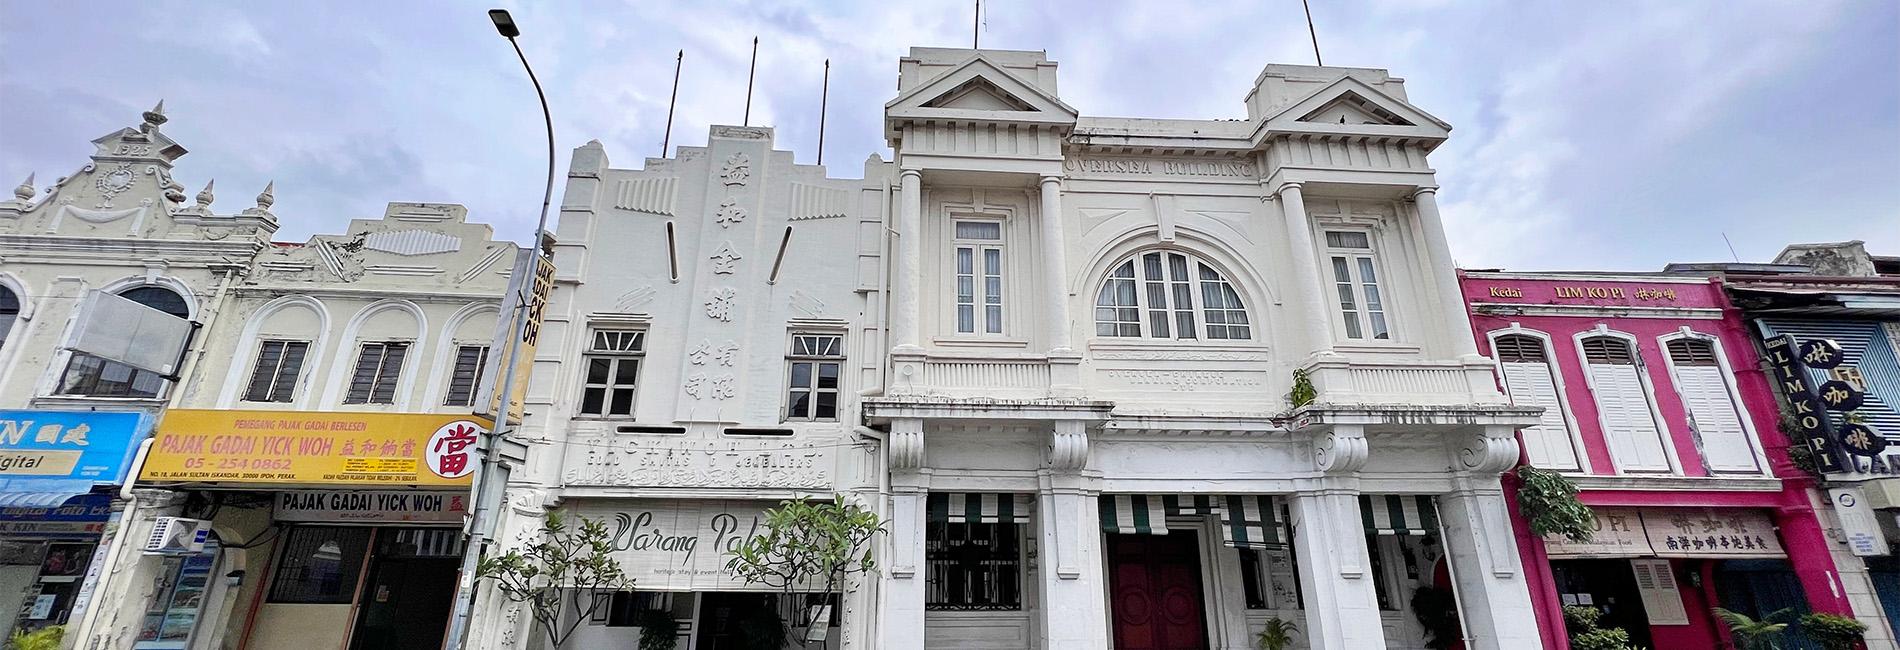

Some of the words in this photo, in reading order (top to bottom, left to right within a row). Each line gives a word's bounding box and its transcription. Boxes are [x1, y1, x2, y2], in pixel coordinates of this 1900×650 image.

[1065, 159, 1152, 174] OVERSEA
[1164, 161, 1252, 177] BUILDING
[1489, 287, 1523, 298] Kedai
[1556, 287, 1583, 299] LIM
[1586, 288, 1608, 299] KO
[1611, 288, 1625, 299] PI
[523, 320, 539, 347] OH
[1774, 351, 1805, 394] LIM
[1794, 400, 1819, 429] KO
[1811, 437, 1833, 467] PI
[278, 421, 301, 431] PAJAK
[304, 421, 328, 431] GADAI
[330, 421, 367, 432] BERLESEN
[160, 434, 208, 454] PAJAK
[211, 435, 256, 455] GADAI
[262, 436, 295, 456] YICK
[298, 436, 334, 457] WOH
[0, 455, 44, 471] gital
[185, 458, 205, 468] 05
[218, 459, 249, 469] 254
[252, 459, 292, 470] 0862
[283, 493, 327, 511] PAJAK
[330, 494, 372, 511] GADAI
[374, 494, 408, 511] YICK
[414, 495, 442, 511] WOH
